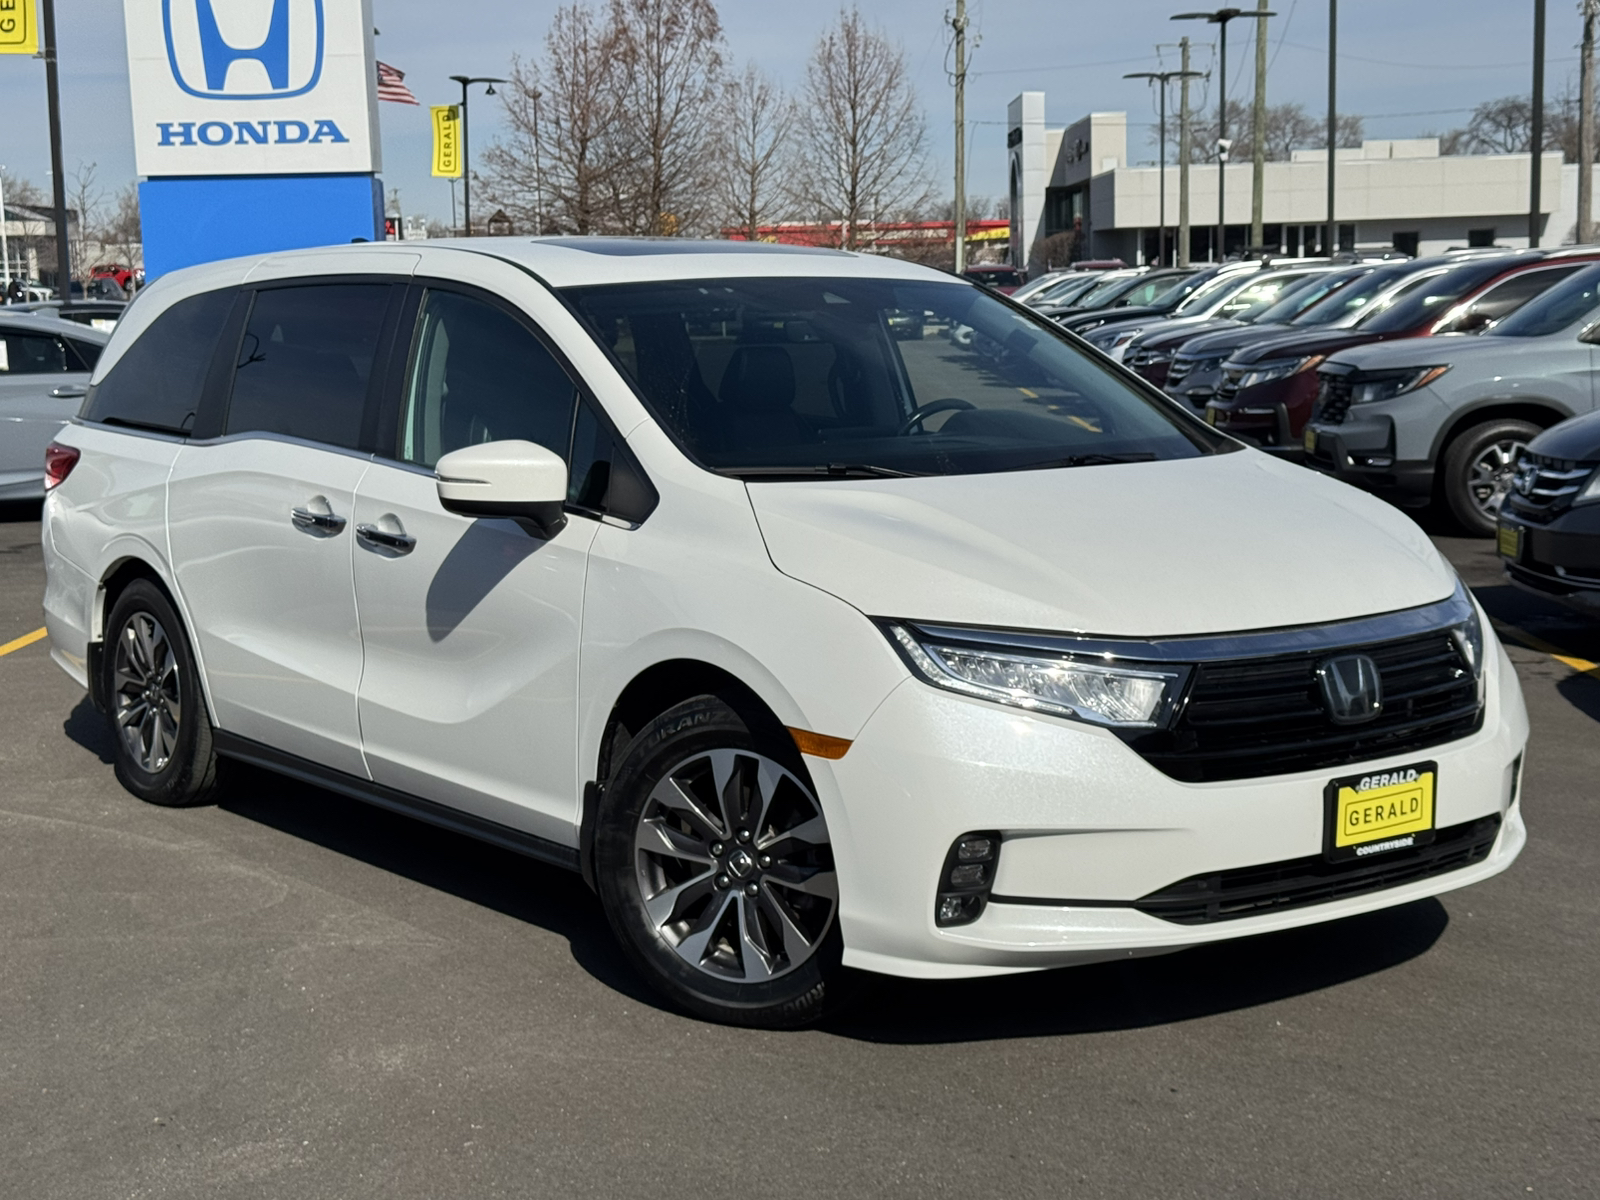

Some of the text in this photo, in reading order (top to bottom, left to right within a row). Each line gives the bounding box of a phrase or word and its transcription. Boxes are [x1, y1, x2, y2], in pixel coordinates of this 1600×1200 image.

[156, 119, 350, 147] HONDA
[442, 114, 452, 168] GERALD
[1360, 768, 1417, 790] GERALD
[1349, 797, 1419, 826] GERALD
[1356, 836, 1415, 856] COUNTRYSIDE
